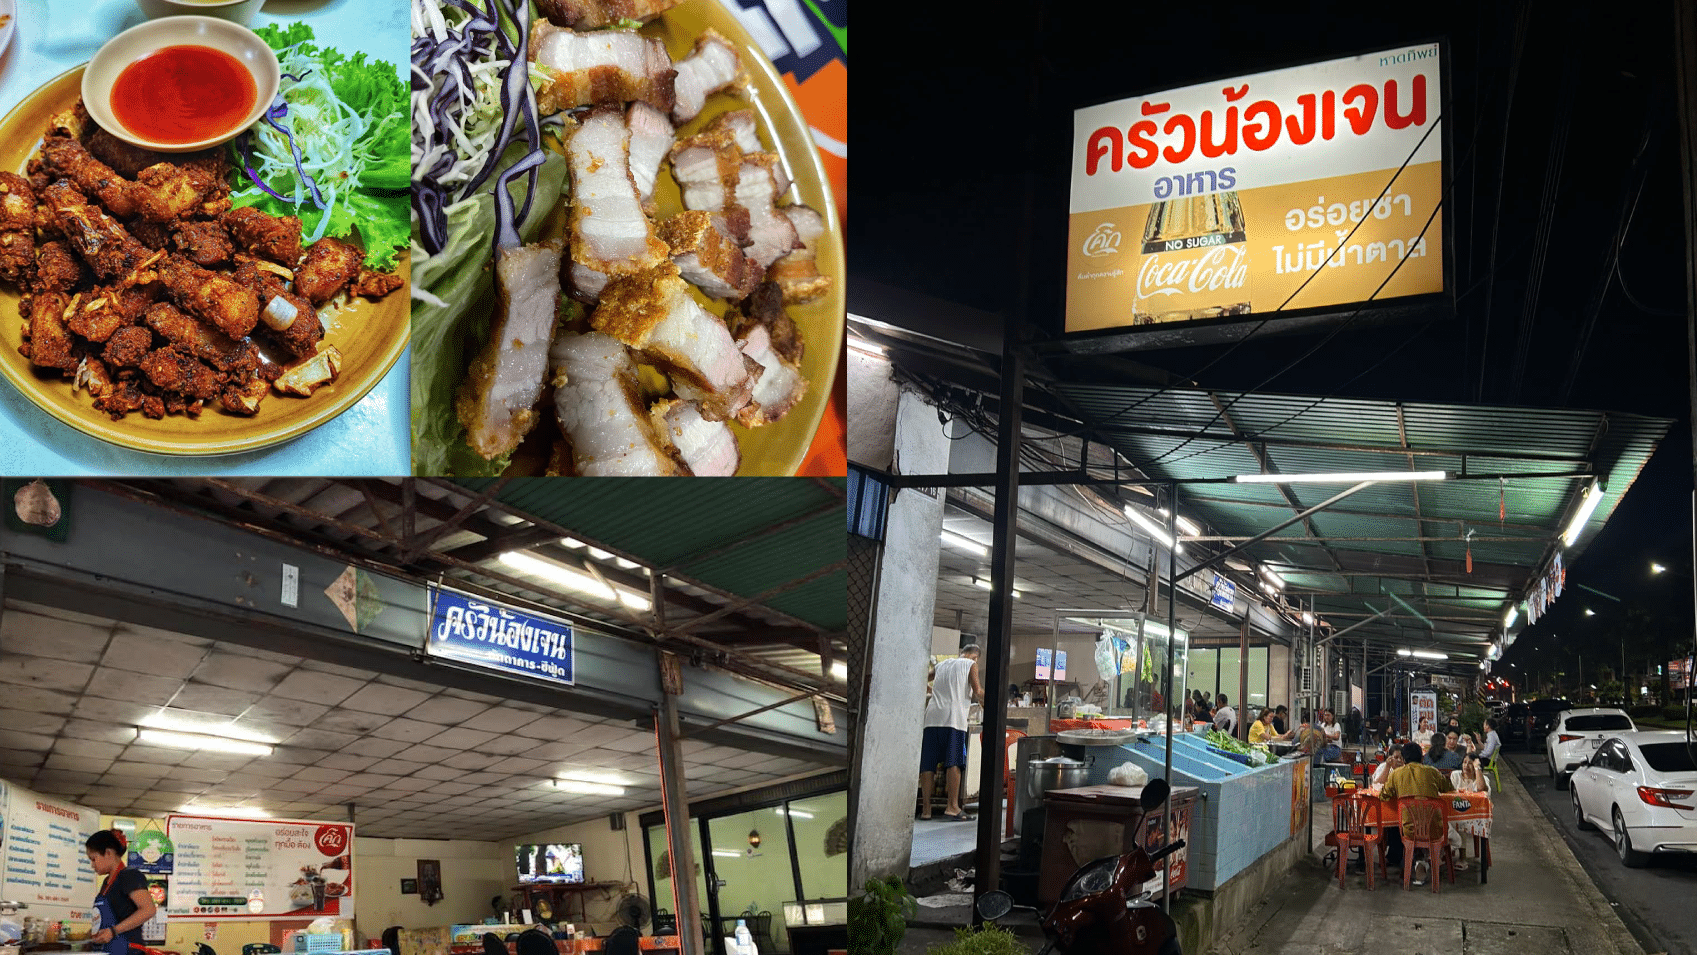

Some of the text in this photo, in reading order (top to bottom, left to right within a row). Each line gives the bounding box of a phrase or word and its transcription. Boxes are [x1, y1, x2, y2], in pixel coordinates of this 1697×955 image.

[1086, 73, 1426, 176] ครัวน้องเจน
[1153, 166, 1236, 199] อาหาร
[1165, 234, 1222, 251] NO SUGAR
[1272, 229, 1426, 274] ไม่มีน้ำตาล
[1136, 244, 1248, 300] Coca-Cola
[438, 601, 566, 660] ครัวน้องเจน
[1452, 800, 1472, 809] FANTA
